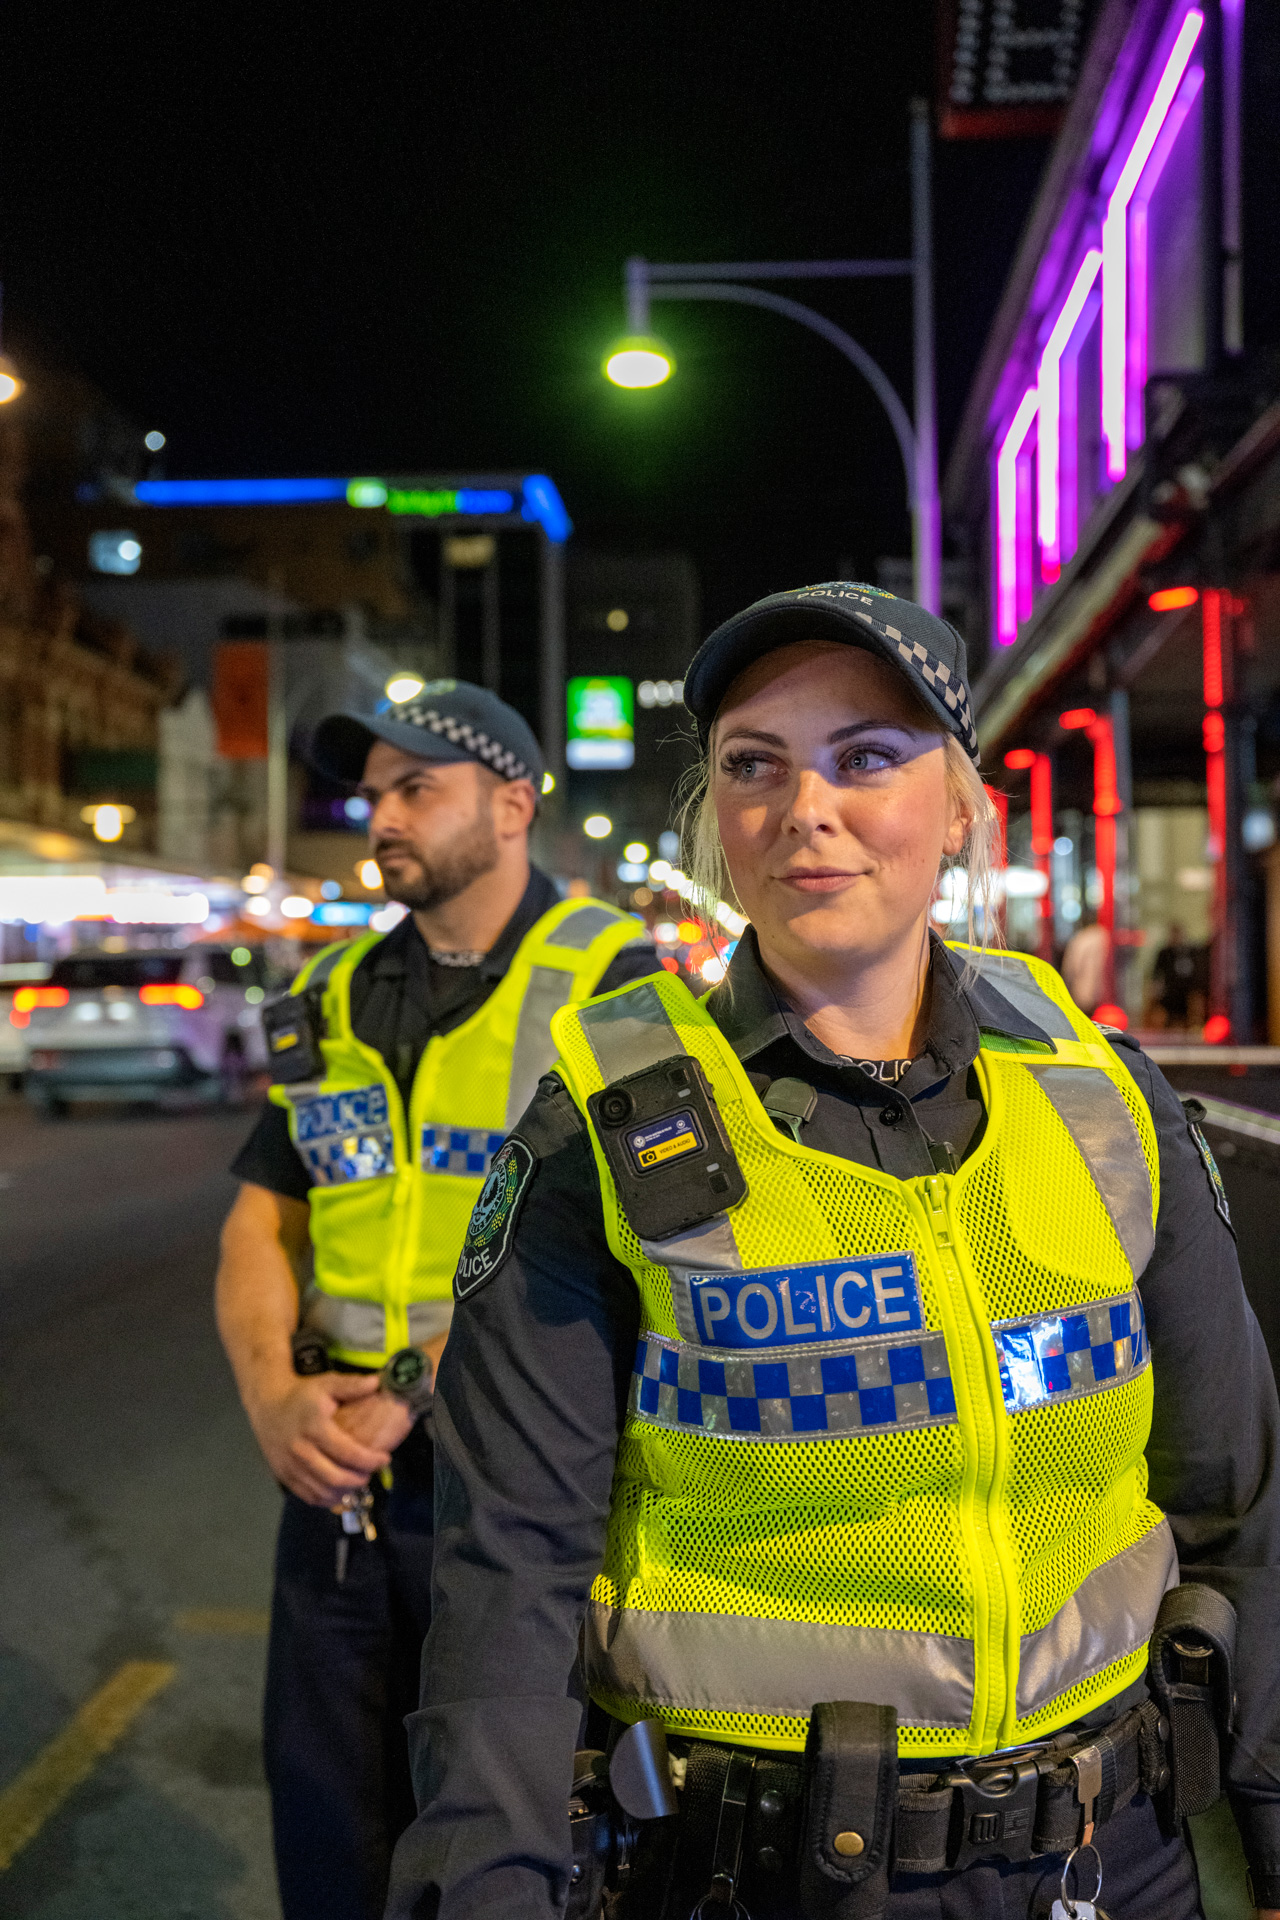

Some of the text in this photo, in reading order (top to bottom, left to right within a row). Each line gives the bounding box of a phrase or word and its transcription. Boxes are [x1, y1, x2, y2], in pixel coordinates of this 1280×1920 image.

[797, 590, 873, 606] POLICE
[839, 1055, 912, 1081] OLIC
[677, 1138, 691, 1147] AUDIO
[700, 1265, 911, 1341] POLICE
